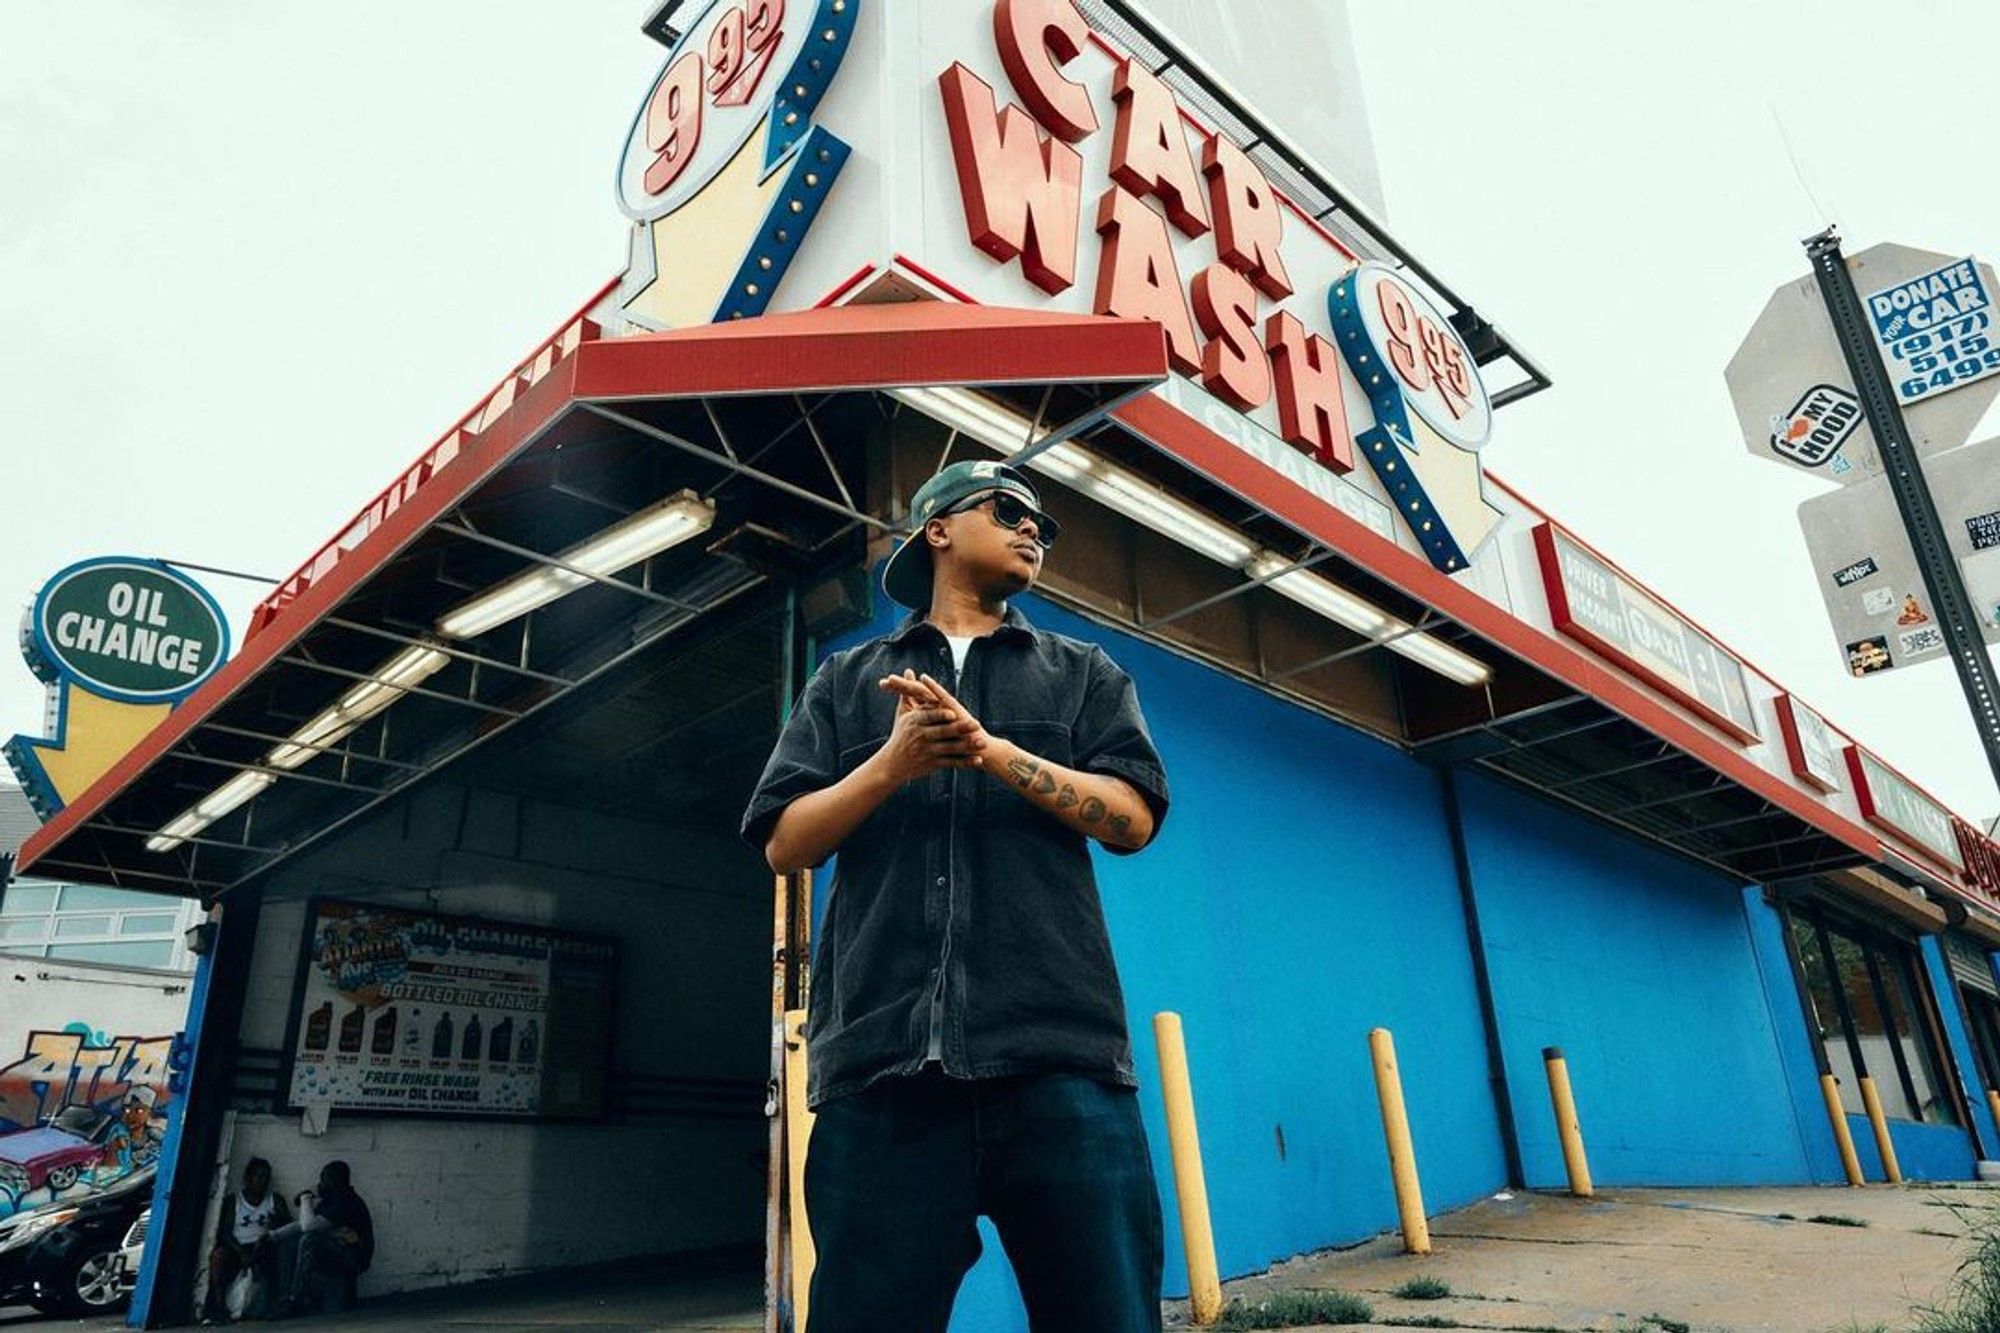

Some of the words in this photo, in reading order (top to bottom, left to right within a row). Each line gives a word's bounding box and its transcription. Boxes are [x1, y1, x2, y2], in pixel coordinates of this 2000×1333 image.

[993, 0, 1293, 302] CAR
[939, 61, 1354, 475] WASH
[1873, 262, 1974, 318] DONATE
[1883, 315, 1906, 341] YOUR
[1907, 286, 1985, 329] CAR
[1892, 311, 1989, 360] (917)
[1900, 348, 2000, 397] 6499
[1909, 333, 1989, 374] 515
[1798, 401, 1857, 460] HOOD
[1802, 391, 1834, 421] MY
[107, 582, 168, 627] OIL
[56, 611, 203, 675] CHANGE
[380, 982, 454, 1003] BOTTLED
[457, 989, 480, 1005] OIL
[485, 991, 548, 1010] CHANGE
[362, 1087, 386, 1096] WITH
[387, 1088, 407, 1098] ANY
[409, 1088, 429, 1100] OIL
[431, 1089, 480, 1102] CHANGE
[364, 1070, 400, 1085] FREE
[400, 1072, 442, 1087] RINSE
[443, 1074, 480, 1088] WASH
